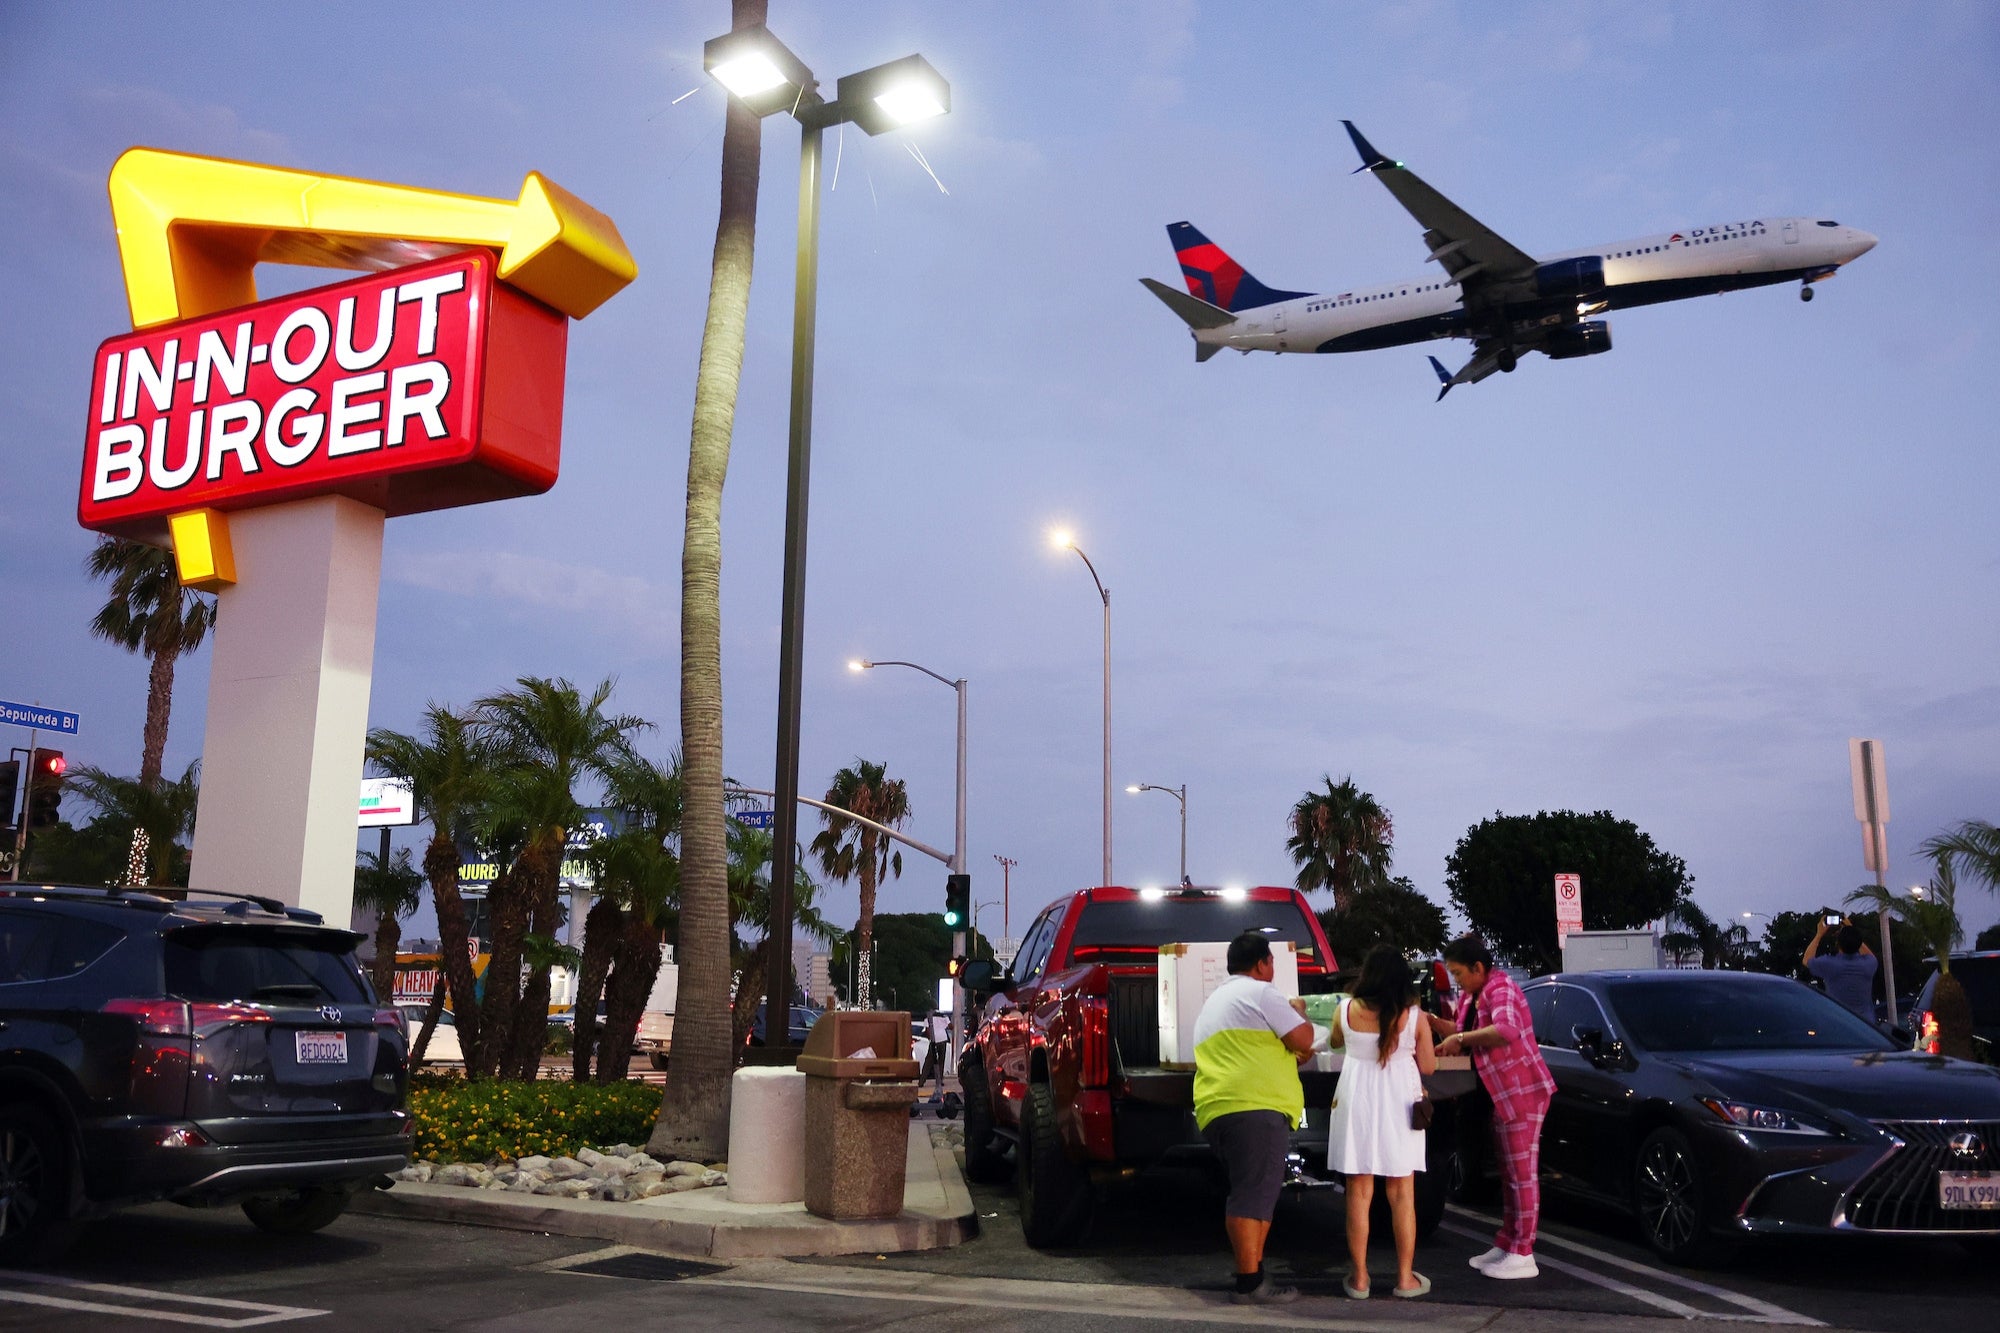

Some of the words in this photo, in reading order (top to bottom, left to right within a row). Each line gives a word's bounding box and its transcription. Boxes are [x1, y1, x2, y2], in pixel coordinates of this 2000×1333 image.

[1692, 221, 1764, 238] DELTA
[99, 270, 466, 424] IN-N-OUT
[92, 360, 450, 501] BURGER
[0, 705, 58, 727] Sepulveda
[738, 815, 762, 825] 92nd
[458, 863, 500, 881] NJURE
